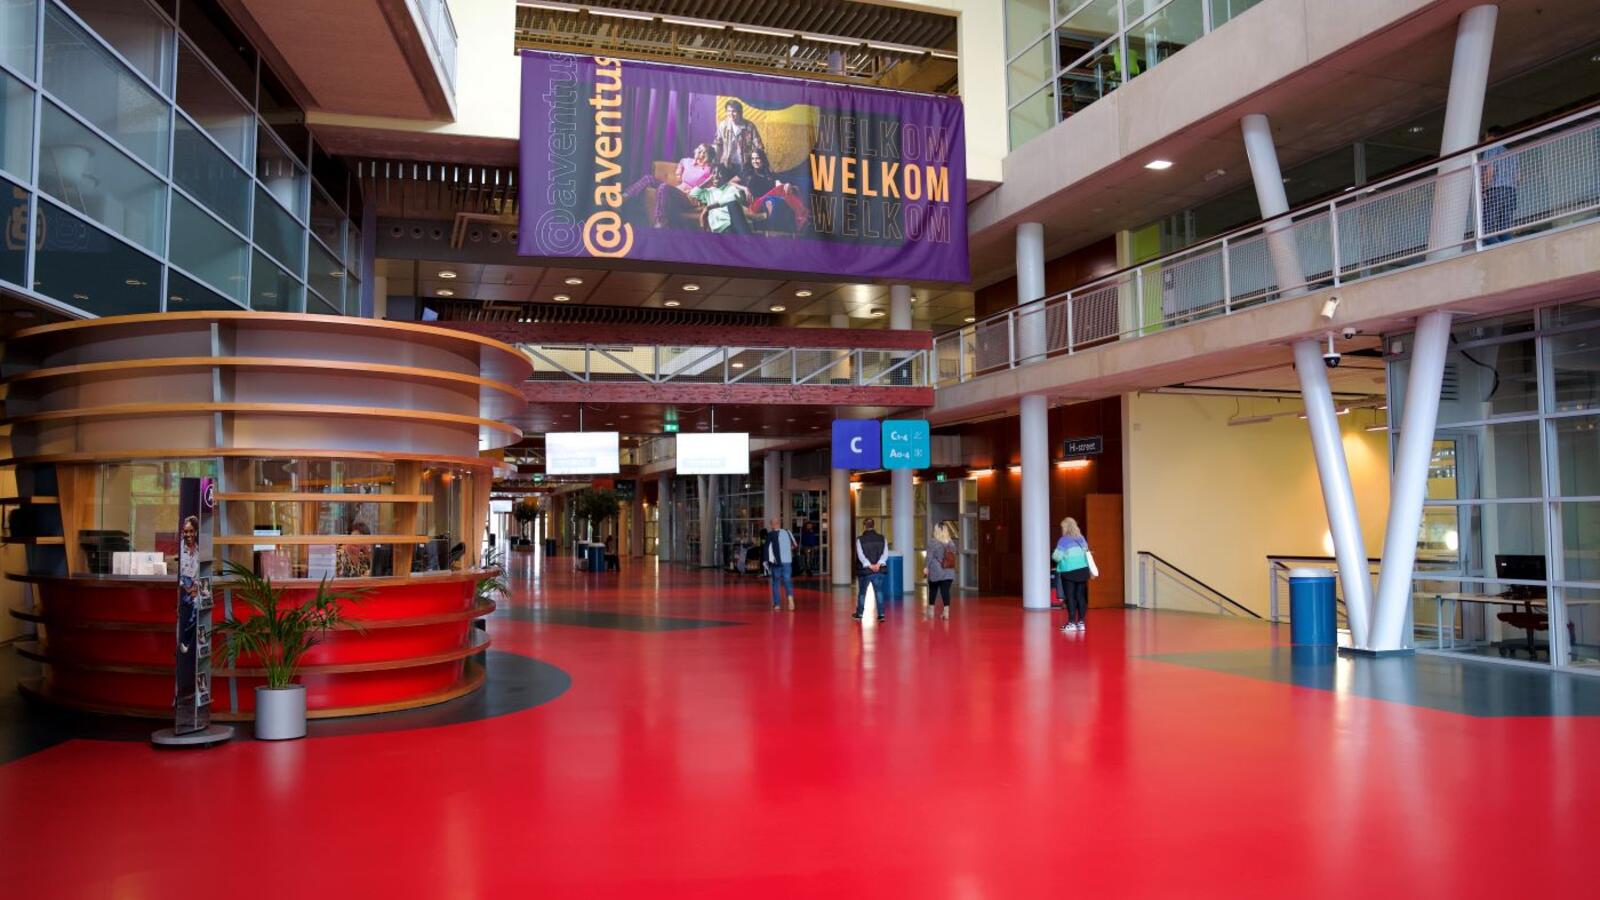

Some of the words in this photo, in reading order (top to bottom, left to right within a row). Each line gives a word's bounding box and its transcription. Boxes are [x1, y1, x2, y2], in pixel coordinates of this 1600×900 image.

[583, 56, 634, 257] @aventus
[814, 114, 949, 163] WELKOM
[810, 153, 949, 203] WELKOM
[810, 194, 951, 243] WELKOM
[850, 436, 863, 454] C
